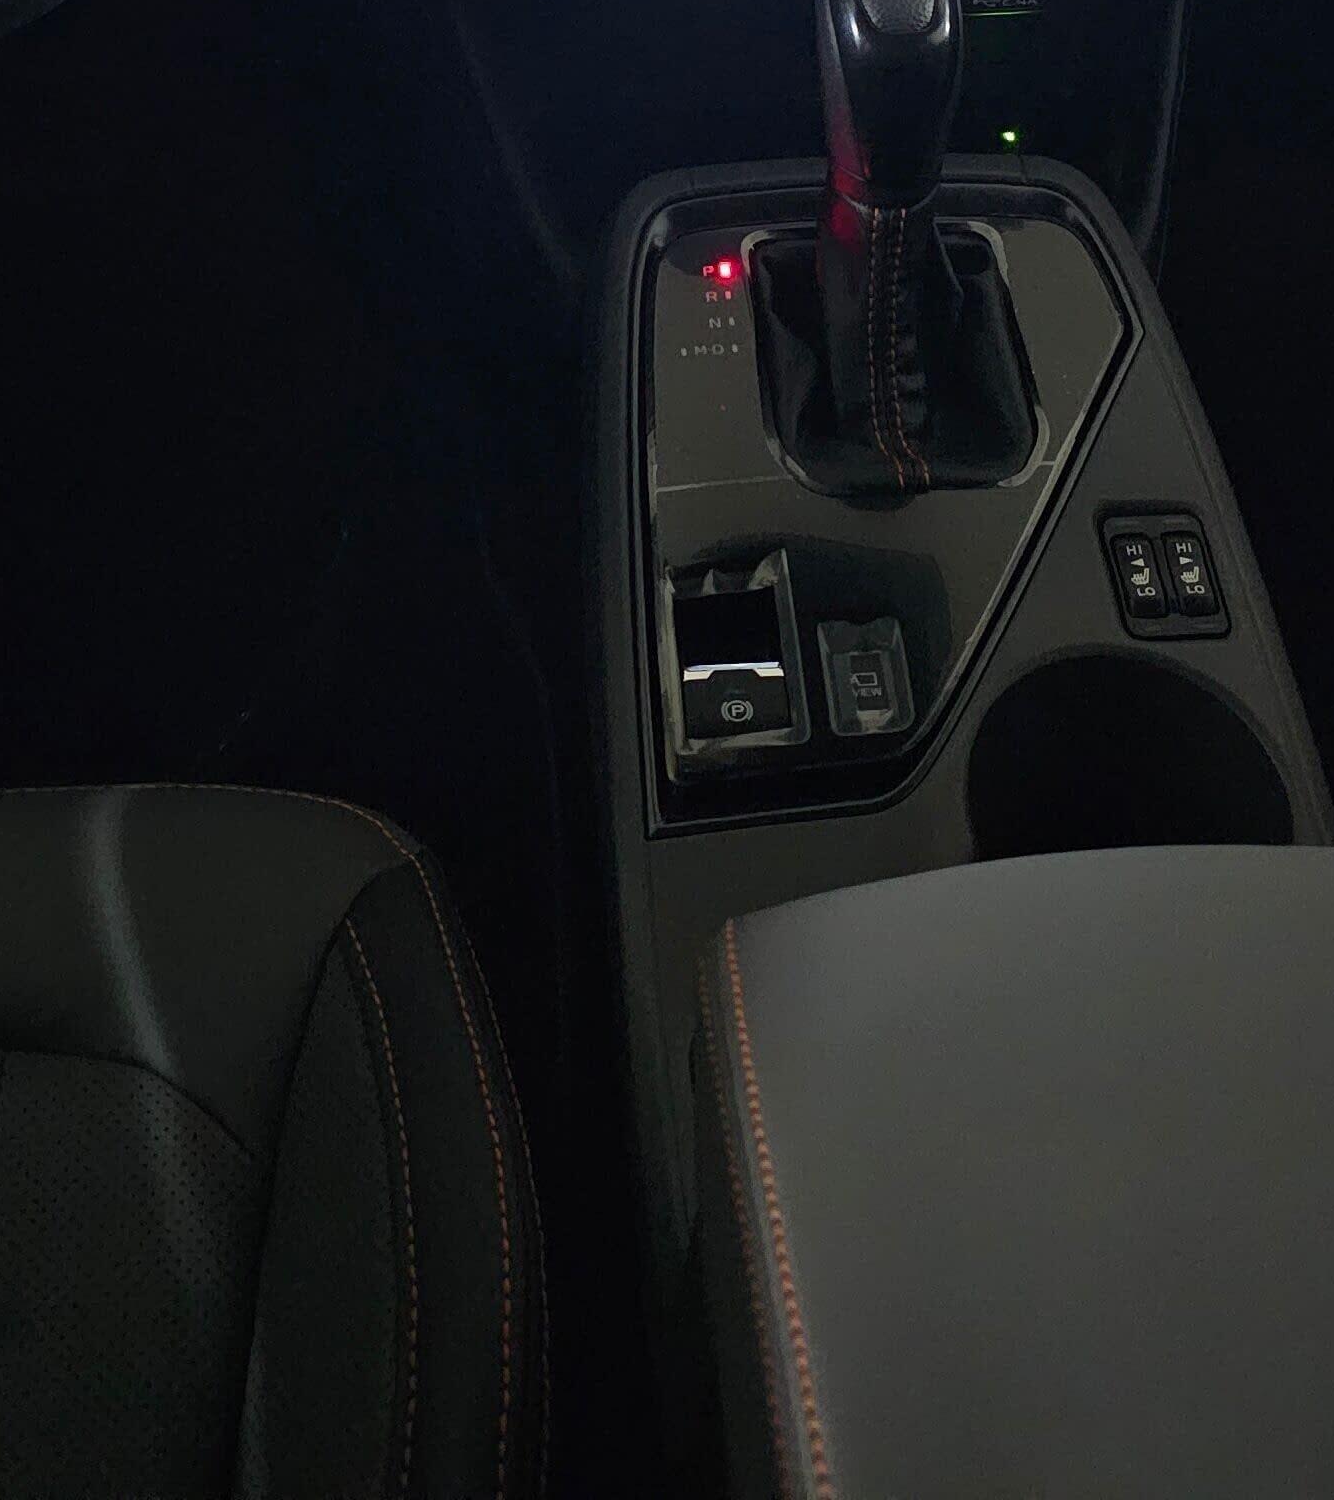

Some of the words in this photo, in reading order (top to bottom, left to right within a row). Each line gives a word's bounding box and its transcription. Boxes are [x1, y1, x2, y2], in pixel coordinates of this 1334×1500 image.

[702, 265, 715, 277] P
[705, 290, 719, 303] R
[708, 316, 722, 329] N
[1126, 543, 1143, 556] HI
[1175, 542, 1193, 554] HI
[1136, 586, 1157, 597] LO
[1186, 584, 1206, 595] LO
[852, 686, 883, 697] VIEW
